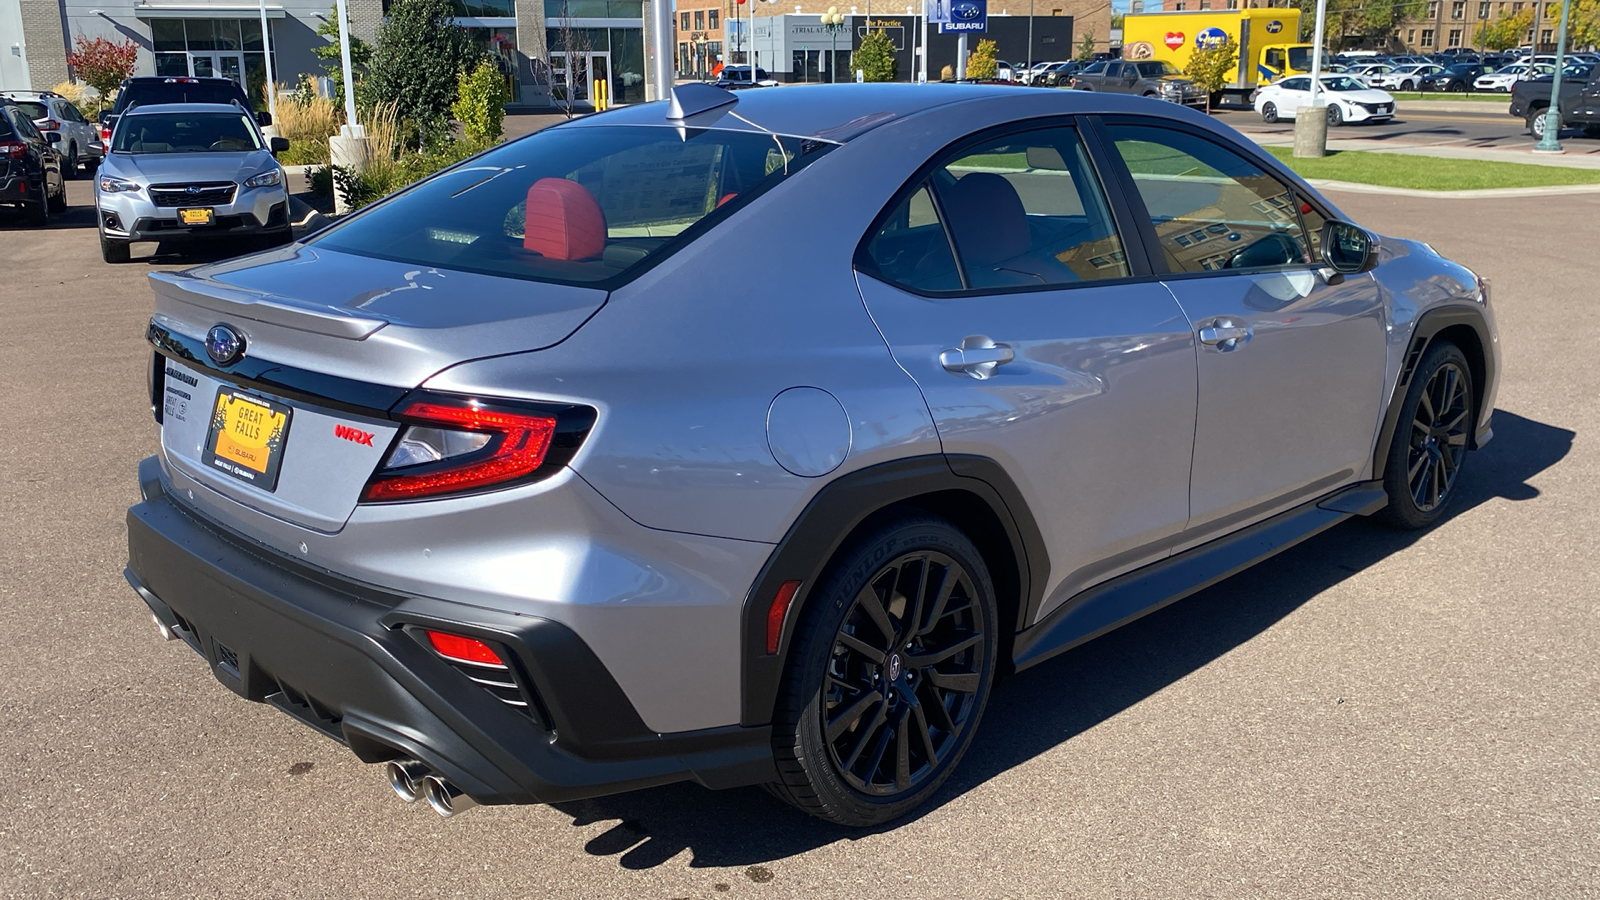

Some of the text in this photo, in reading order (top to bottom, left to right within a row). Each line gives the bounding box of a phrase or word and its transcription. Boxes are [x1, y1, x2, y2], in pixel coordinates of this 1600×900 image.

[877, 19, 902, 27] Practice
[945, 22, 984, 30] SUBARU
[165, 366, 199, 388] SUBARU
[238, 406, 264, 426] GREAT
[234, 420, 261, 440] FALLS
[334, 423, 376, 448] WRX
[234, 447, 257, 463] SUBARU
[834, 537, 898, 613] DUNLOP
